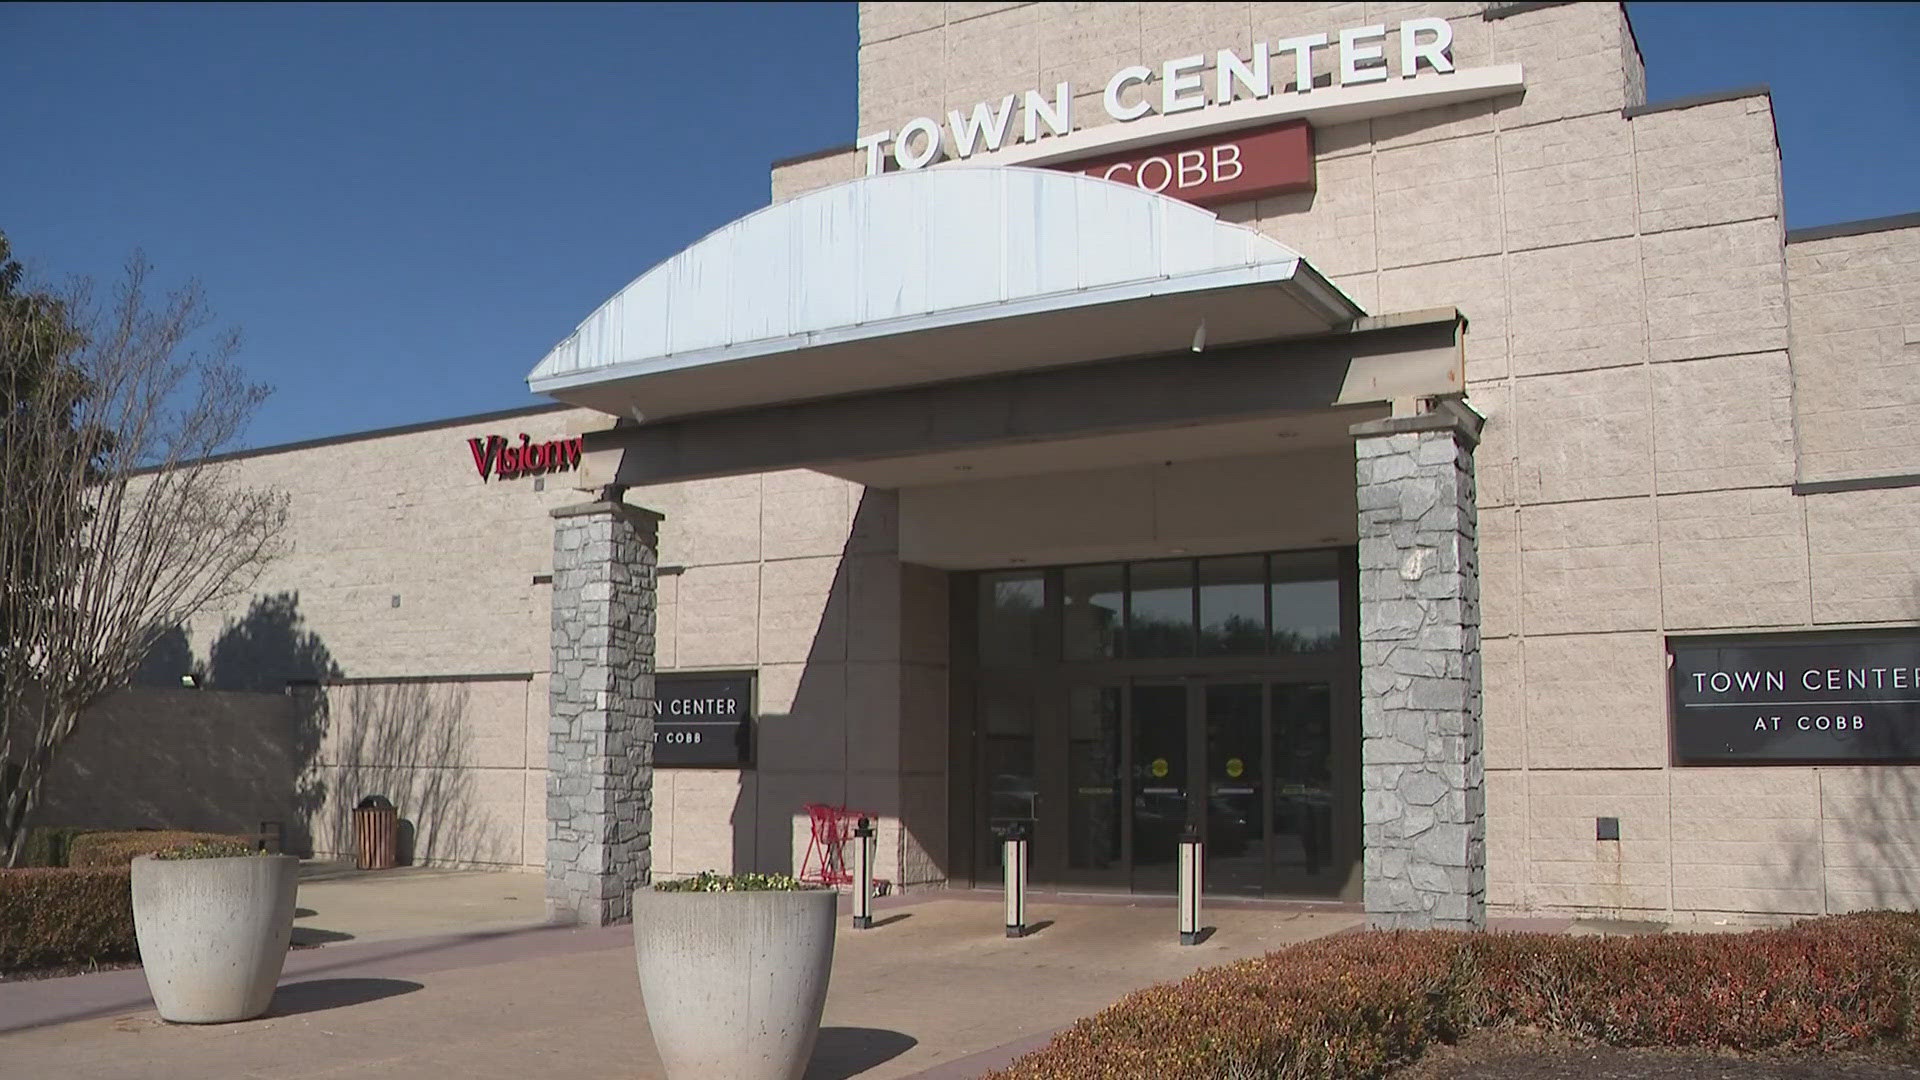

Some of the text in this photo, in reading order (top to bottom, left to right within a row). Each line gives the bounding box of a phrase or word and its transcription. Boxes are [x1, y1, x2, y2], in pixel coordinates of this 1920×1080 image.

[856, 17, 1455, 175] TOWN CENTER
[1692, 670, 1785, 693] TOWN
[670, 699, 737, 715] CENTER
[1754, 715, 1865, 732] AT COBB
[666, 732, 702, 744] COBB
